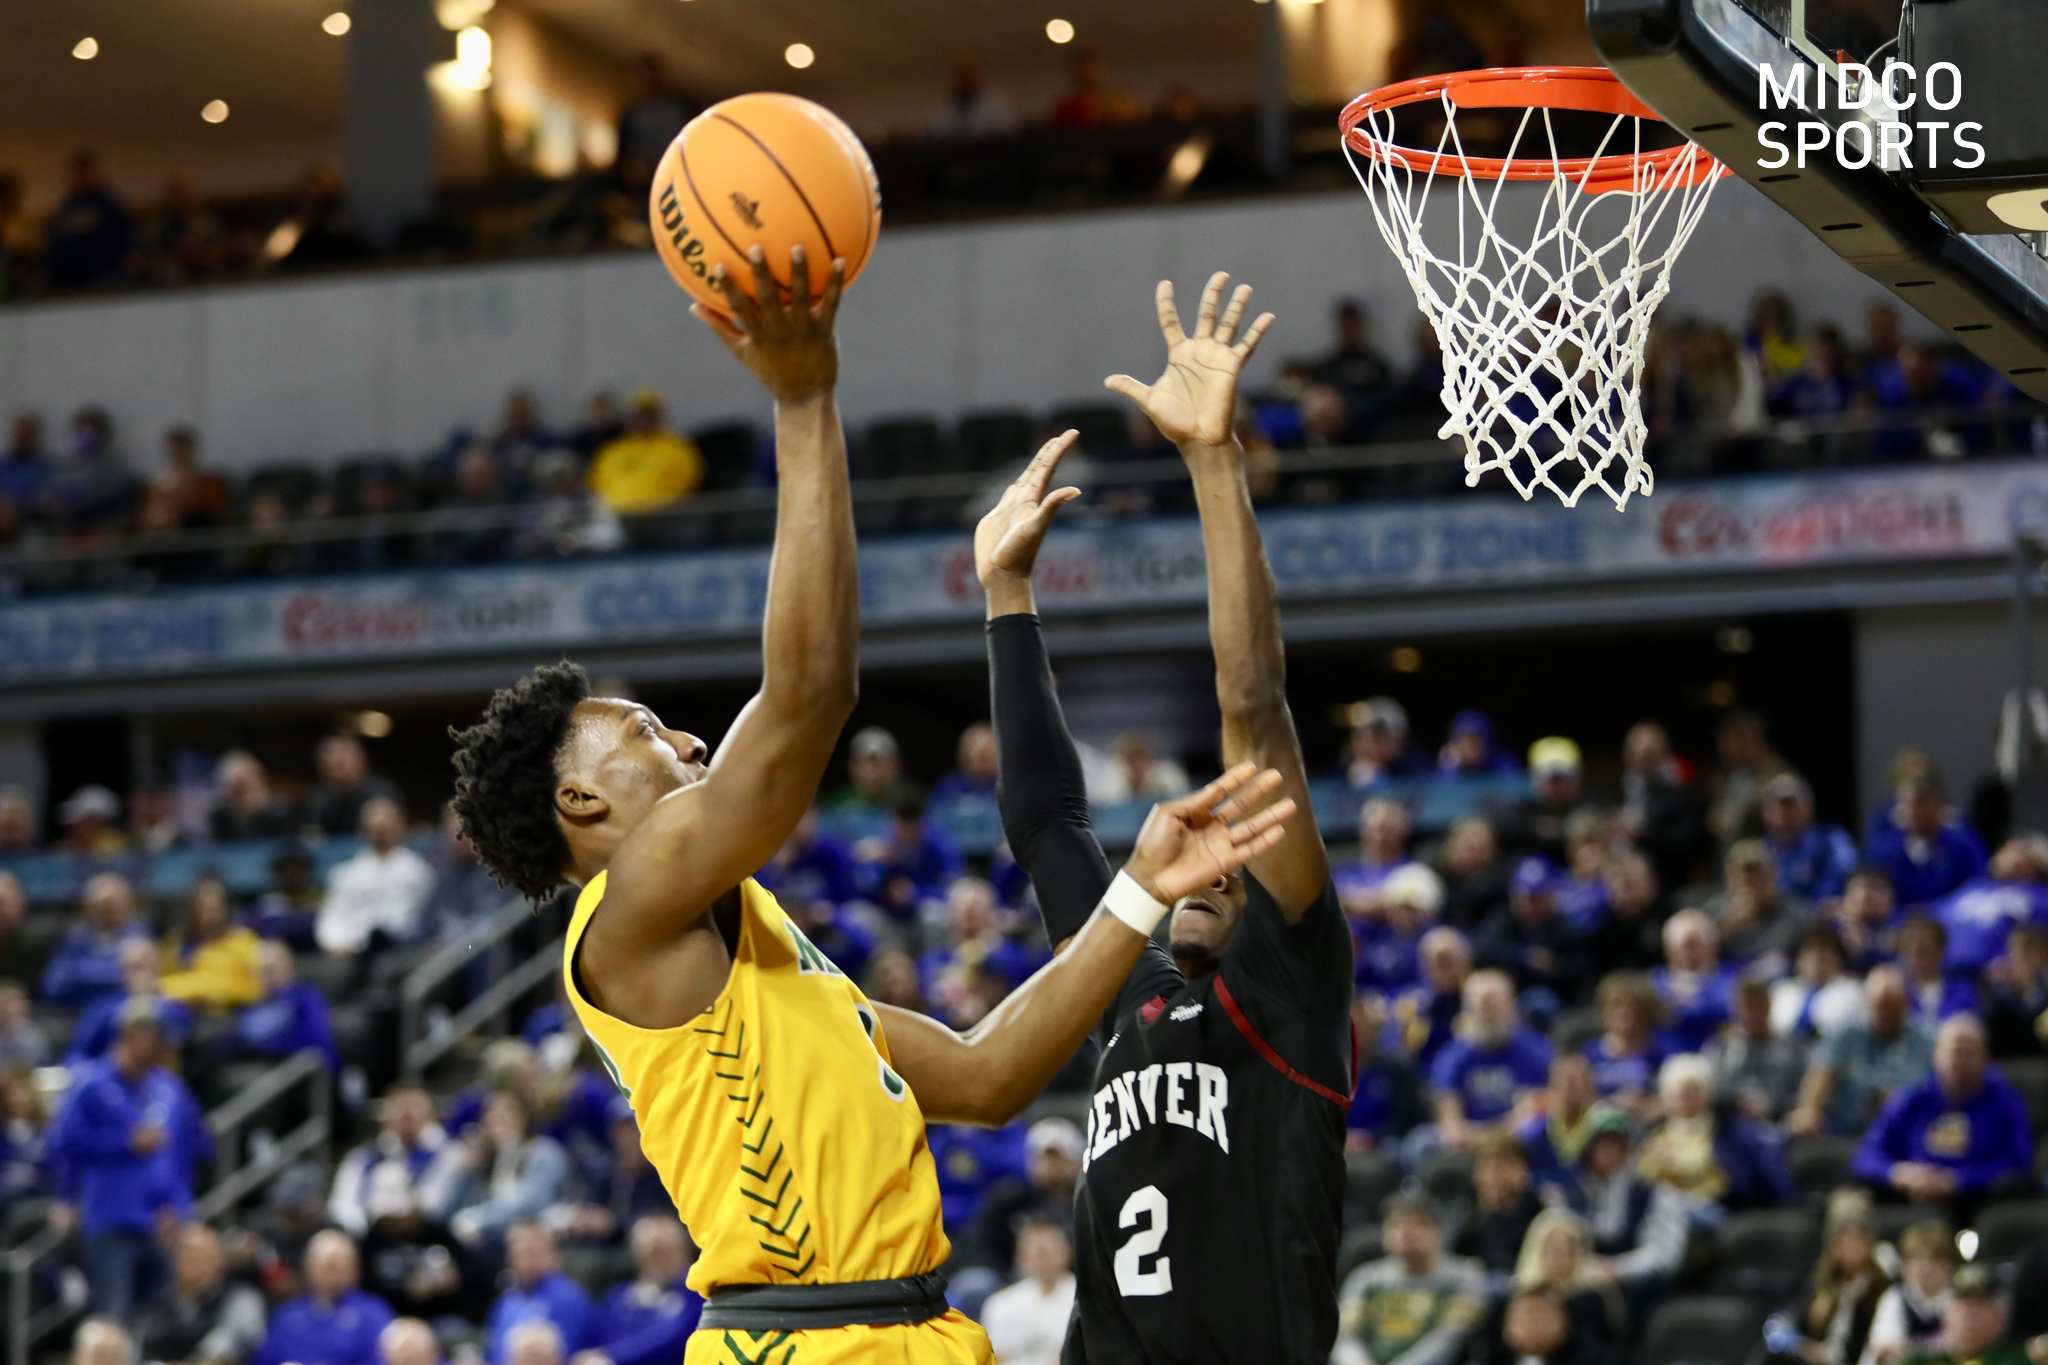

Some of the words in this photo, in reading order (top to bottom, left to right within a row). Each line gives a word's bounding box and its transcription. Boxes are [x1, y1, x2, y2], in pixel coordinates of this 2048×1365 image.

[660, 178, 725, 294] Wilso
[1274, 522, 1421, 585] COLD
[1113, 1184, 1173, 1297] 2
